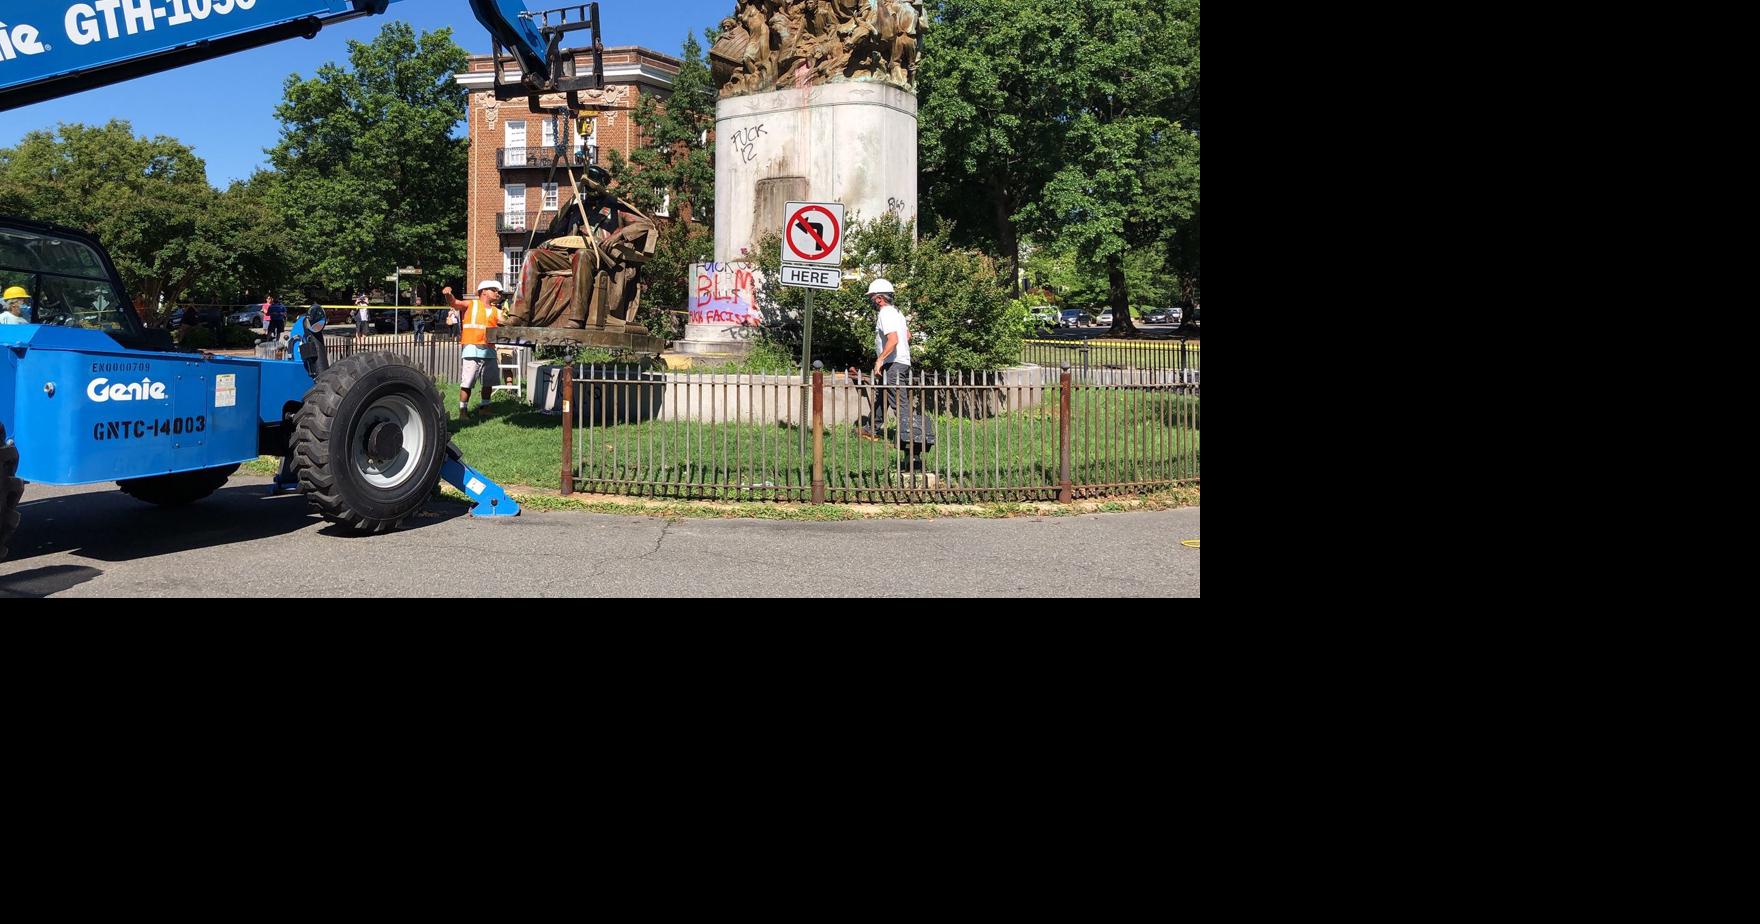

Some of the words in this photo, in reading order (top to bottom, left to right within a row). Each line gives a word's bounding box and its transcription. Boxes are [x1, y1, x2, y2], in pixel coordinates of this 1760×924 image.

[64, 0, 257, 46] GTH-1
[730, 124, 768, 152] FUCK
[740, 142, 757, 164] 12
[697, 269, 757, 308] BLM
[791, 270, 829, 284] HERE
[87, 377, 166, 403] Genie
[93, 415, 206, 441] GNTC-14003
